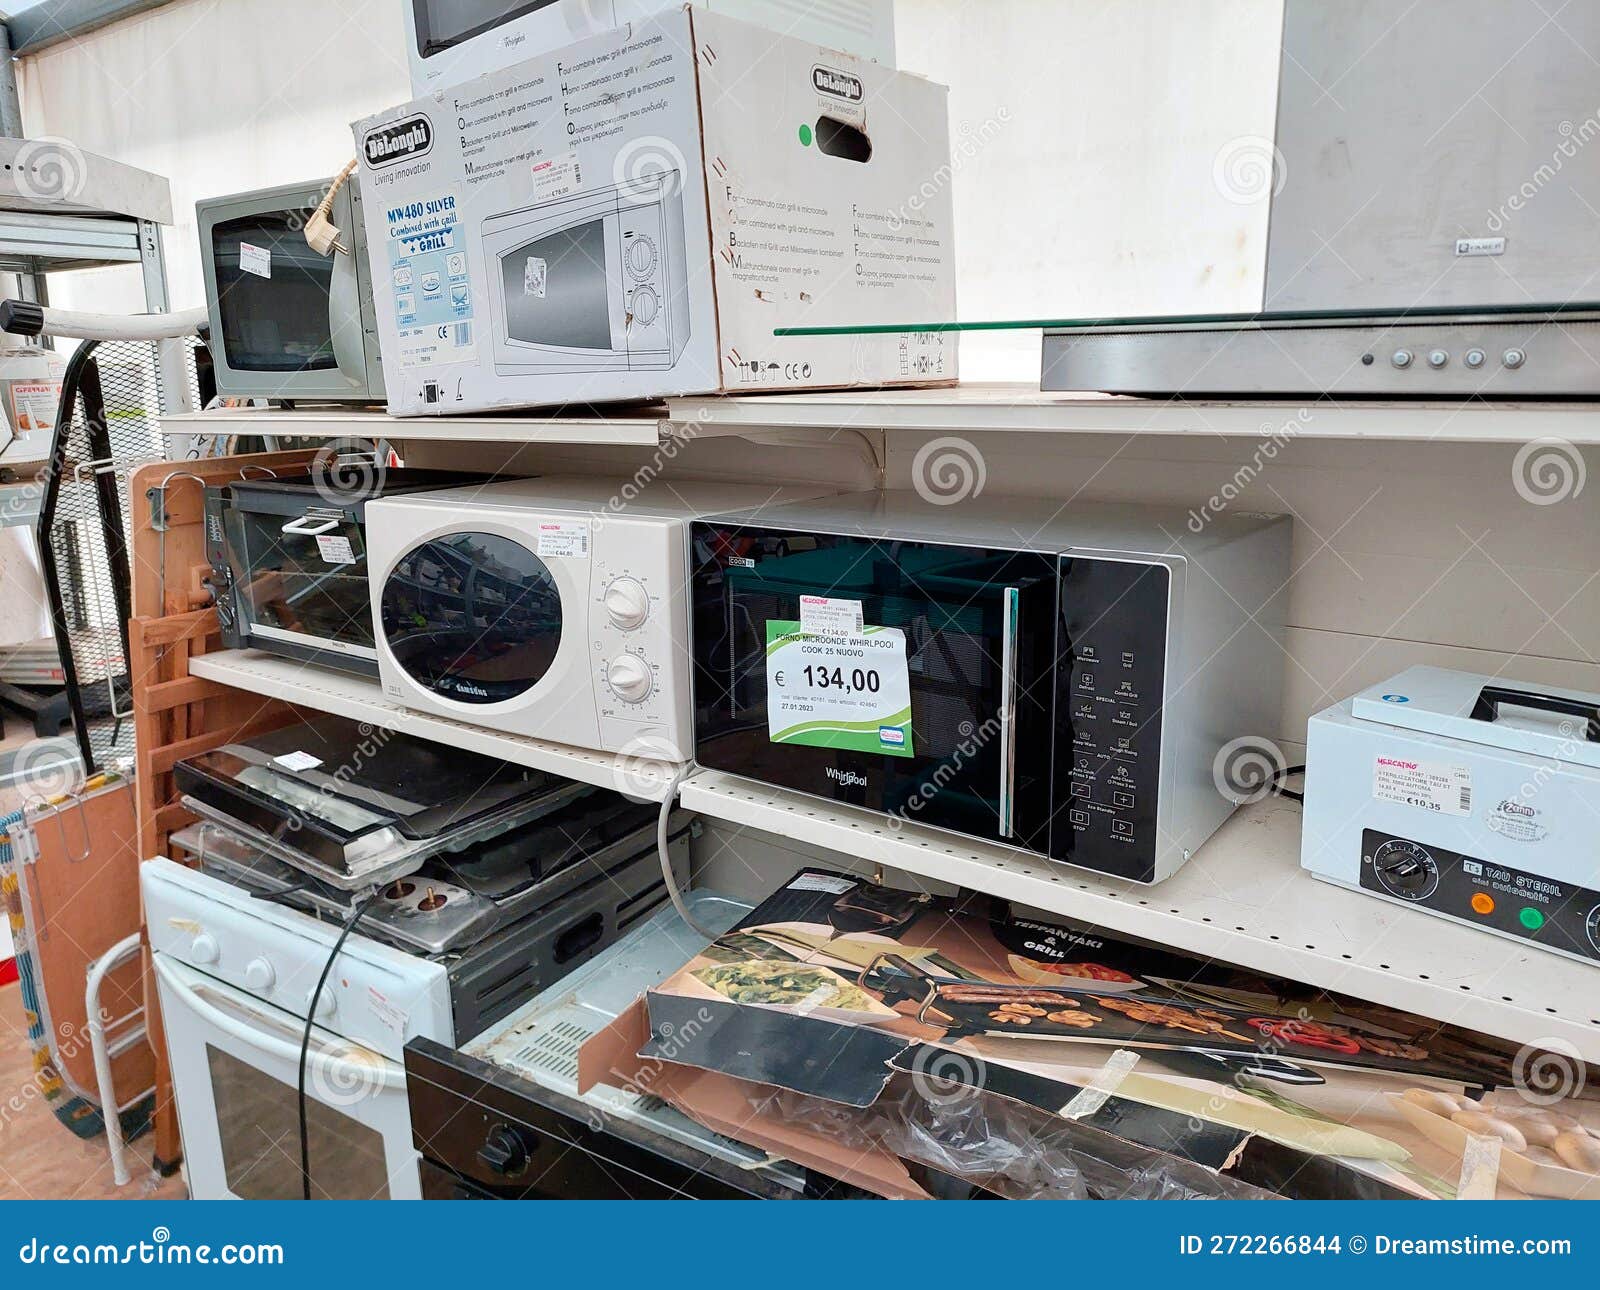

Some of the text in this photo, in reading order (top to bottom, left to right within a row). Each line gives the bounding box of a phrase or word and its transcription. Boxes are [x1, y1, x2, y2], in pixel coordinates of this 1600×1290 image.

[375, 161, 431, 186] Living innovation
[388, 196, 456, 224] MW480 SILVER
[390, 220, 423, 238] Combined
[424, 218, 439, 230] with
[420, 237, 446, 251] GRILL
[776, 633, 801, 642] FORNO
[803, 635, 847, 646] MICROONDE
[801, 646, 864, 657] COOK 25 NUOVO
[775, 664, 880, 694] € 134,00
[1378, 757, 1417, 770] MERCATINO
[825, 766, 867, 787] Whirlpool
[1486, 867, 1562, 897] TAU STERIL
[1014, 921, 1103, 949] TEPPANYAKI
[1044, 936, 1056, 946] &
[1024, 941, 1065, 958] GRILL
